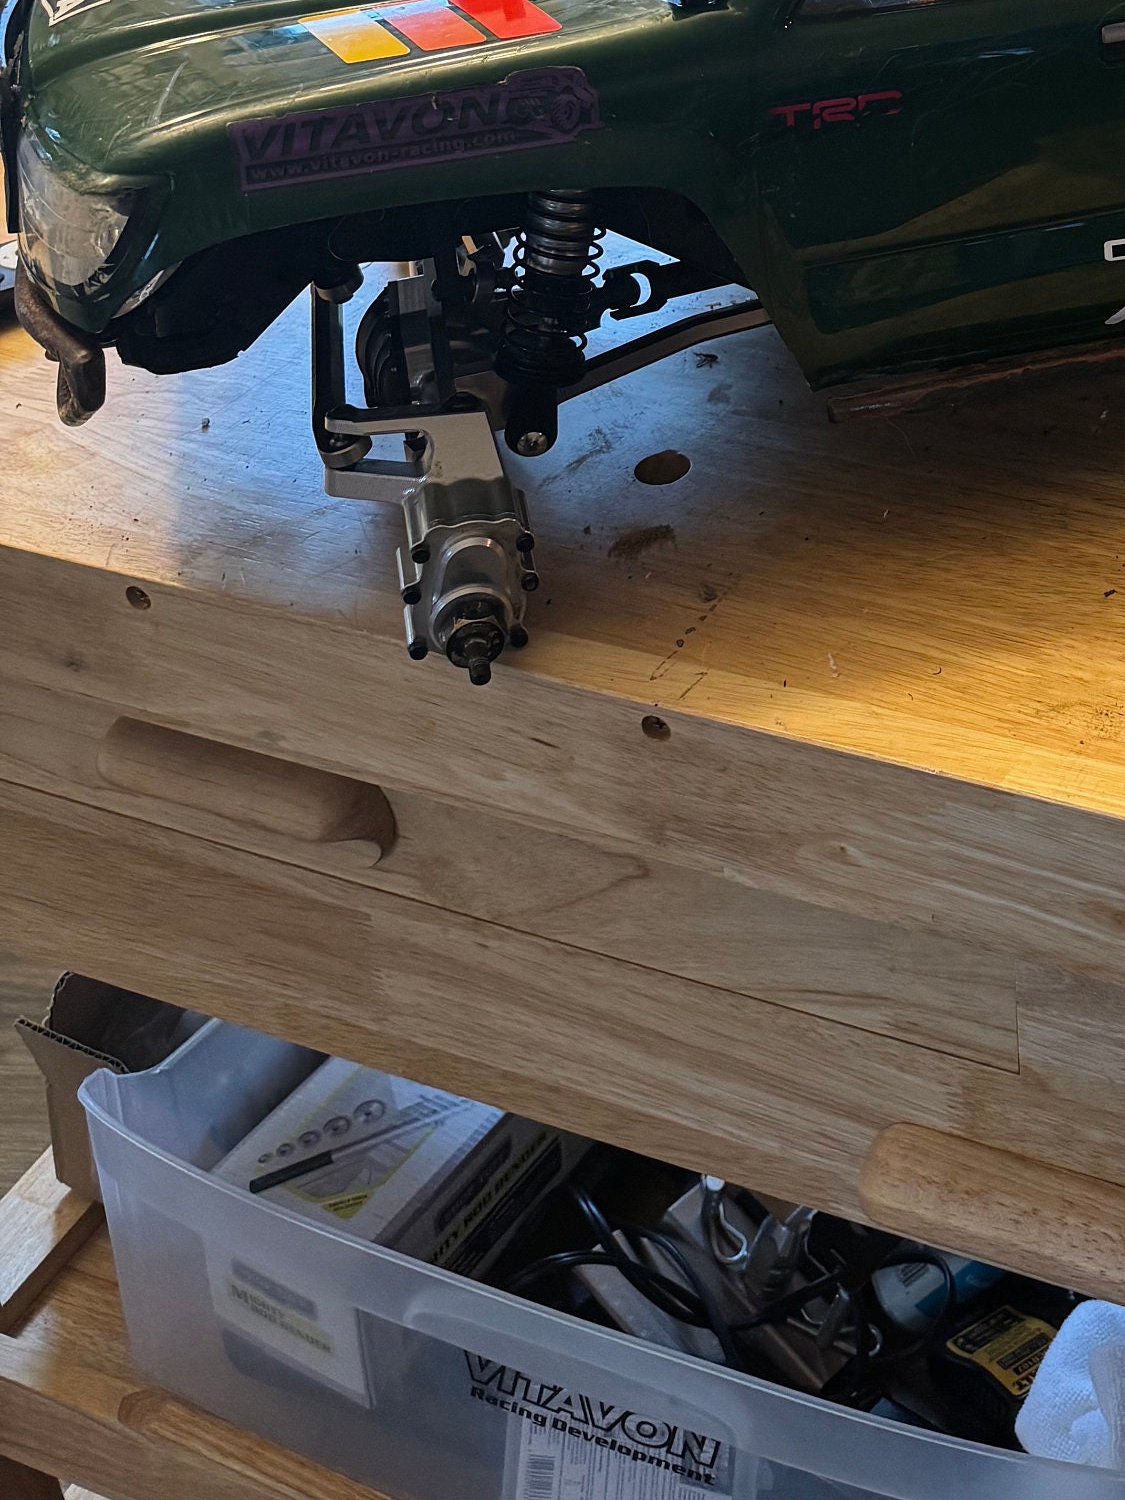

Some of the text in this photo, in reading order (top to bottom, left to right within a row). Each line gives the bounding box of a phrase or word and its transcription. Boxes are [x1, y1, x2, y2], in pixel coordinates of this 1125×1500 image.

[241, 95, 503, 162] VITAVON
[252, 130, 516, 181] www.vitavon-racing.com
[464, 1350, 721, 1469] VITAVON
[470, 1385, 547, 1428] Racing
[552, 1418, 717, 1486] Development
